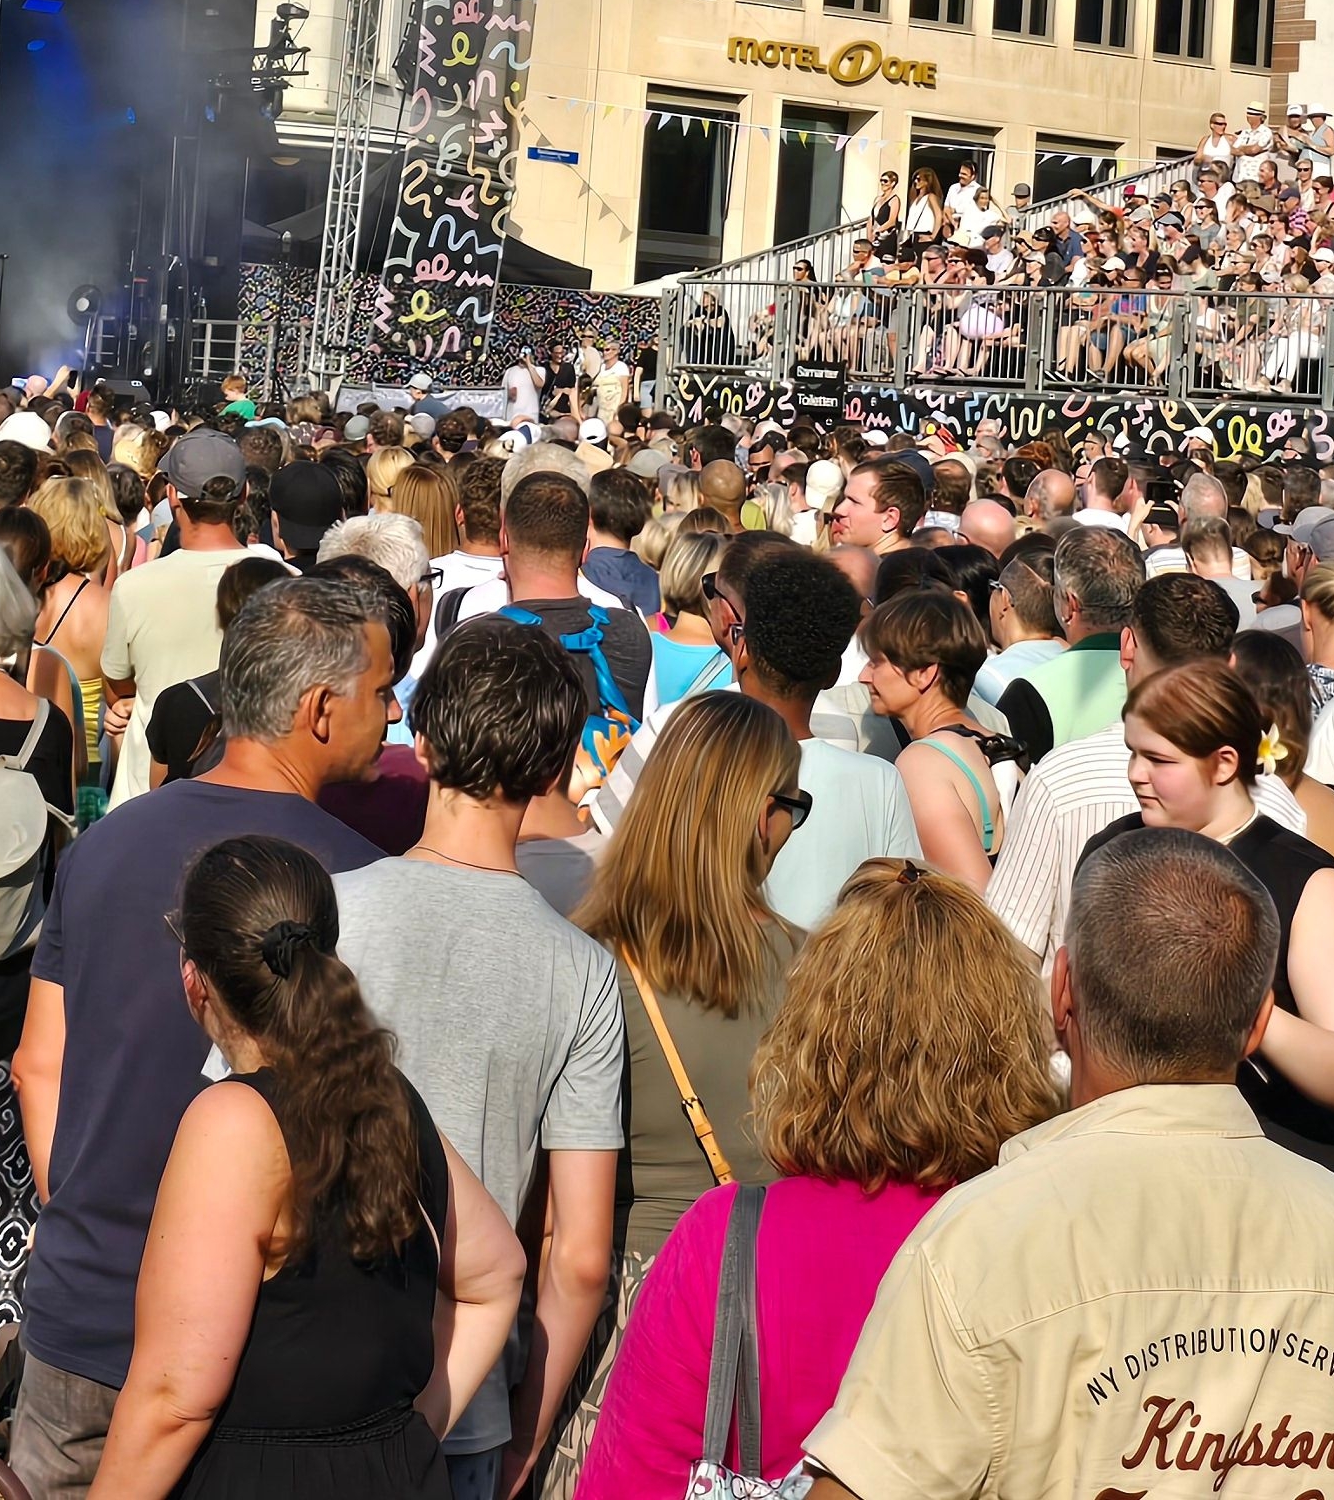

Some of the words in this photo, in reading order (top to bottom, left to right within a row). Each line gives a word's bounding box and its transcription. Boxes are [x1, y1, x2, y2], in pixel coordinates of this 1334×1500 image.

[727, 37, 827, 74] MOTEL
[881, 56, 937, 89] ONE
[1086, 1366, 1120, 1406] NY
[1124, 1327, 1281, 1380] DISTRIBUTION
